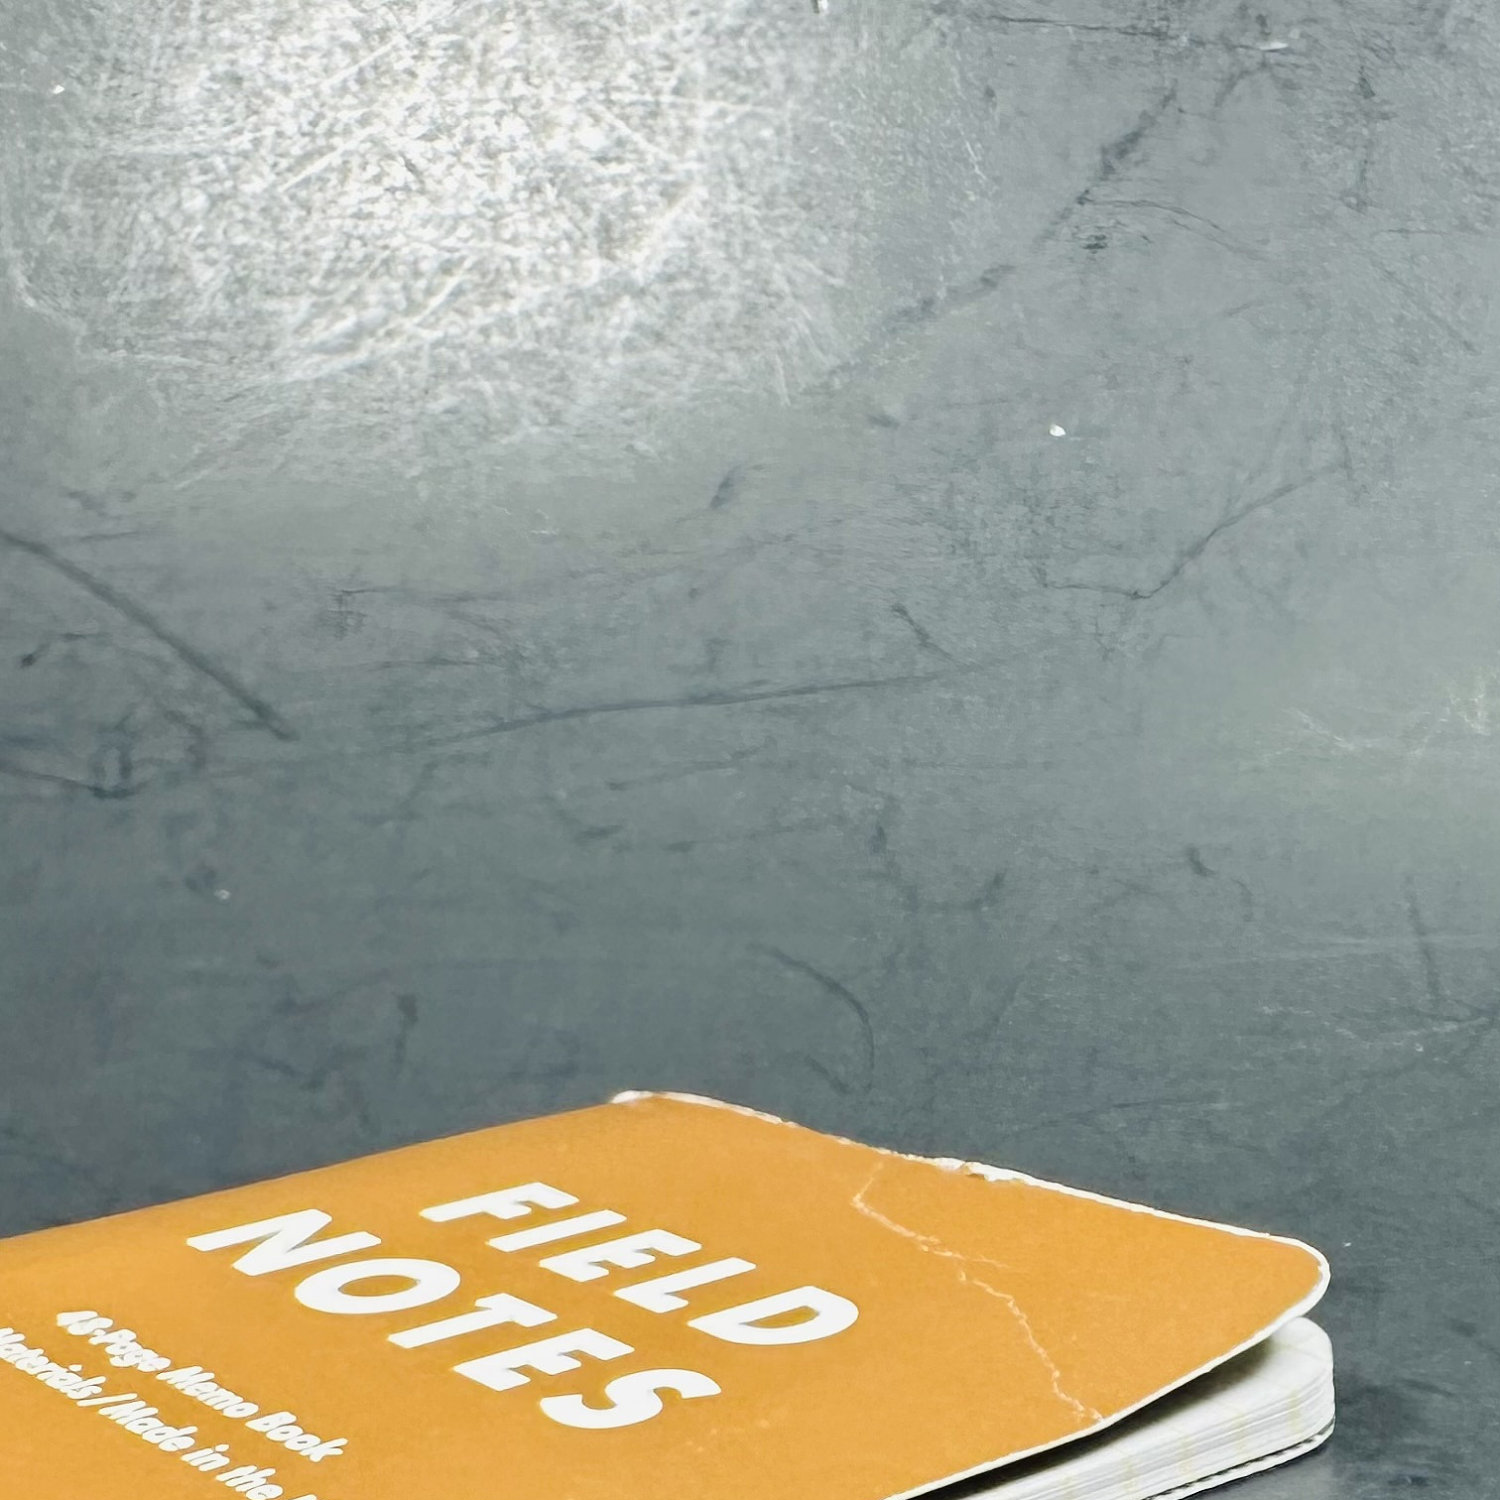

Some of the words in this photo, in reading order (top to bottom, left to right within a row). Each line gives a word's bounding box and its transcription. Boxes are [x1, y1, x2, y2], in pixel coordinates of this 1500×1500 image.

[186, 1208, 722, 1429] NOTES
[419, 1181, 859, 1346] FIELD
[56, 1310, 172, 1373] 48-Page
[156, 1365, 259, 1419] Memo
[245, 1411, 348, 1463] Book
[98, 1400, 198, 1452] Made
[180, 1443, 230, 1472] in
